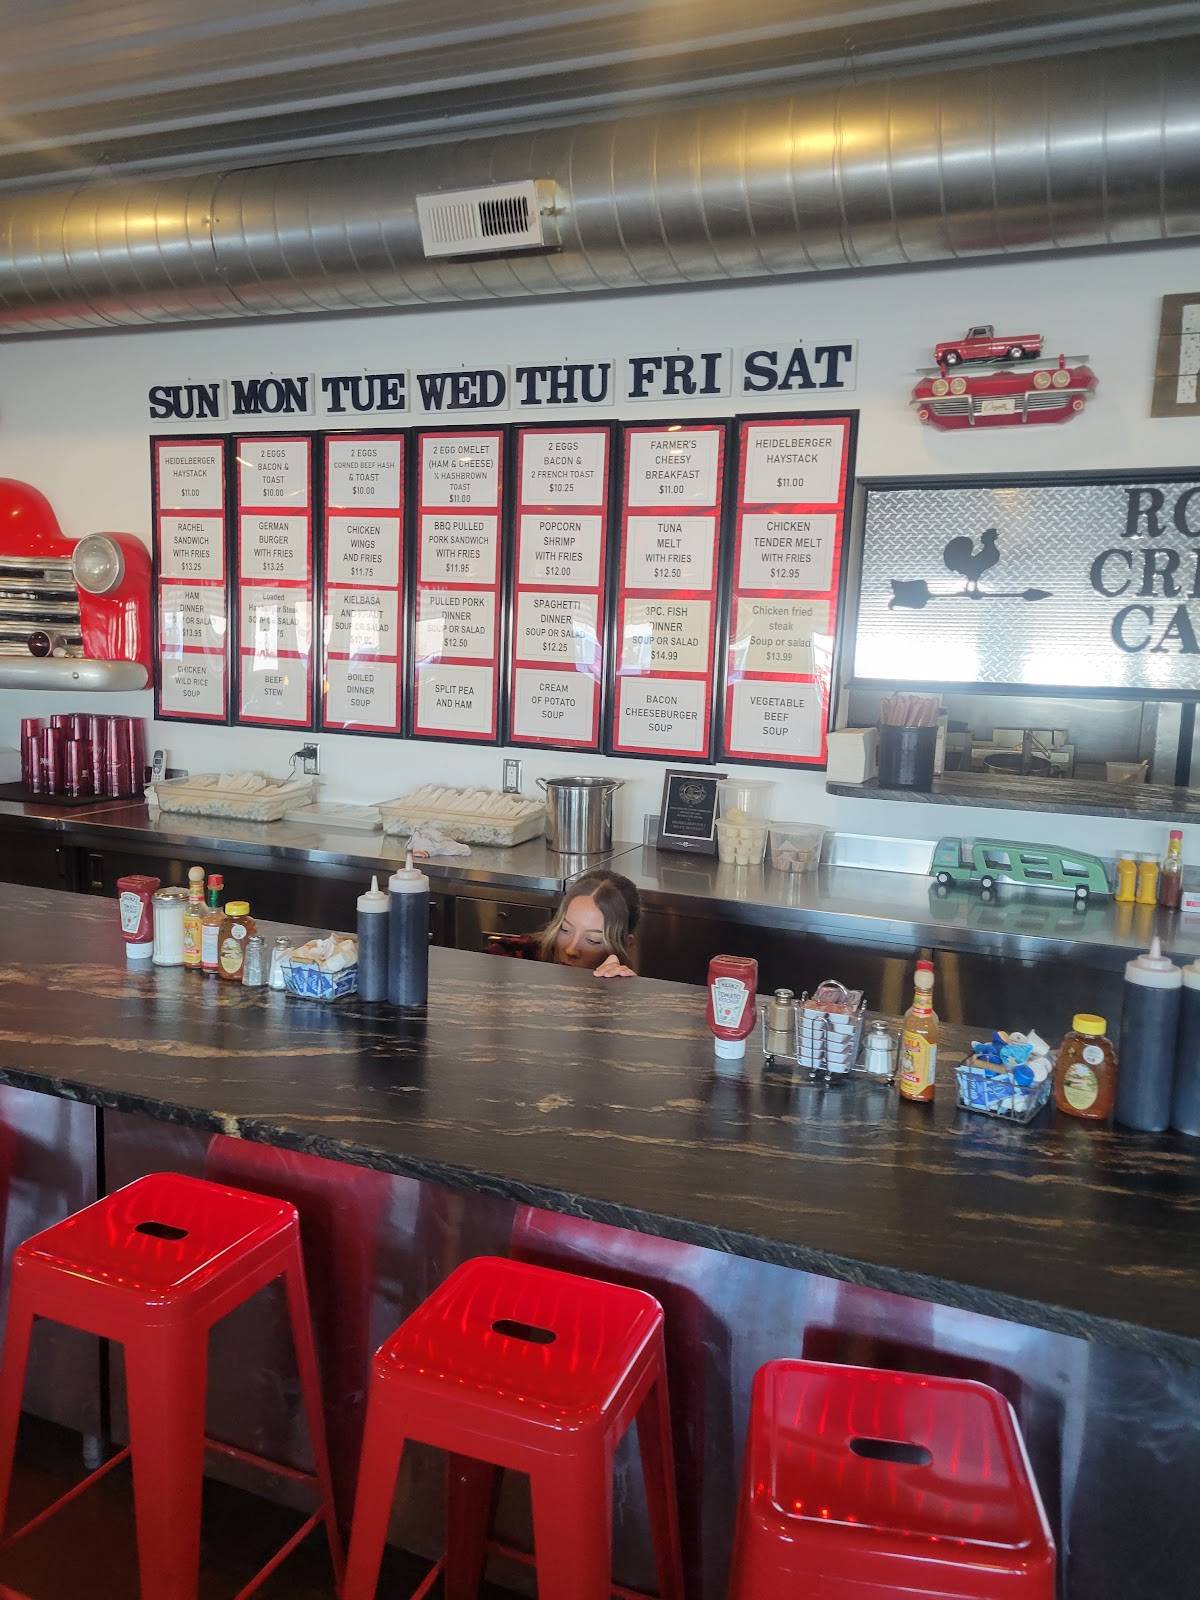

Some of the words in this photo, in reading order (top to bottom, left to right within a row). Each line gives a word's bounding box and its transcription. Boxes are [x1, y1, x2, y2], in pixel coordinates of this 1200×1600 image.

[744, 345, 852, 391] SAT
[628, 353, 721, 397] FRI
[516, 363, 611, 405] THU
[322, 373, 405, 412] TUE
[417, 370, 506, 410] WED
[232, 377, 308, 414] MON
[149, 384, 220, 418] SUN
[555, 443, 578, 451] EGGS
[756, 438, 832, 448] HEIDELBERGER
[458, 446, 490, 454] OMELET
[544, 457, 573, 465] BACON
[655, 456, 691, 464] CHEESY
[767, 454, 818, 463] HAYSTACK
[646, 471, 700, 479] BREAKFAST
[777, 478, 804, 487] $11.00
[550, 484, 574, 492] $10.25
[659, 485, 684, 494] $11.00
[181, 489, 199, 497] $11.00
[263, 489, 284, 497] $10.00
[178, 523, 204, 532] RACHEL
[259, 522, 289, 530] GERMAN
[347, 526, 380, 535] CHICKEN
[434, 522, 451, 530] BBQ
[453, 522, 484, 531] PULLED
[540, 522, 581, 531] POPCORN
[658, 524, 682, 533] TUNA
[767, 522, 810, 531] CHICKEN
[174, 537, 209, 545] SANDWICH
[259, 536, 288, 544] BURGER
[351, 540, 375, 548] WINGS
[543, 537, 576, 546] SHRIMP
[657, 539, 681, 548] MELT
[754, 538, 793, 548] TENDER
[796, 538, 822, 548] MELT
[190, 550, 210, 558] FRIES
[254, 549, 271, 557] WITH
[274, 550, 293, 558] FRIES
[361, 554, 382, 562] FRIES
[436, 549, 455, 558] WITH
[458, 550, 480, 558] FRIES
[536, 552, 556, 561] WITH
[559, 552, 583, 561] FRIES
[646, 554, 665, 562] WITH
[668, 554, 691, 562] FRIES
[761, 553, 783, 562] WITH
[786, 554, 811, 562] FRIES
[263, 563, 284, 571] $13.25
[351, 567, 373, 576] $11.75
[446, 564, 469, 573] $11.95
[546, 567, 571, 576] $12.00
[654, 568, 681, 578] $12.50
[770, 568, 800, 578] $12.95
[344, 596, 380, 605] KIELBASA
[430, 597, 460, 606] PULLED
[462, 598, 484, 607] PORK
[534, 600, 581, 610] SPAGHETTI
[180, 604, 204, 612] DINNER
[668, 607, 688, 617] FISH
[752, 606, 789, 615] Chicken
[792, 607, 813, 616] fried
[541, 615, 571, 624] DINNER
[449, 625, 459, 633] OR
[461, 626, 485, 634] SALAD
[769, 622, 793, 630] steak
[1112, 604, 1200, 653] CA
[526, 628, 545, 636] SOUP
[548, 629, 559, 637] OR
[444, 638, 468, 647] $12.50
[632, 636, 654, 644] SOUP
[656, 637, 668, 645] OR
[670, 638, 698, 646] SALAD
[750, 636, 773, 647] Soup
[788, 637, 811, 648] salad
[542, 642, 567, 652] $12.25
[651, 651, 678, 660] $14.99
[178, 666, 206, 674] CHICKEN
[175, 677, 191, 685] WILD
[435, 685, 456, 693] SPLIT
[458, 686, 474, 694] PEA
[539, 684, 568, 692] CREAM
[436, 699, 452, 707] AND
[544, 697, 576, 706] POTATO
[647, 696, 677, 704] BACON
[750, 697, 805, 707] VEGETABLE
[542, 711, 564, 719] SOUP
[626, 708, 697, 720] CHEESEBURGER
[764, 712, 789, 721] BEEF
[648, 723, 672, 732] SOUP
[762, 727, 789, 735] SOUP
